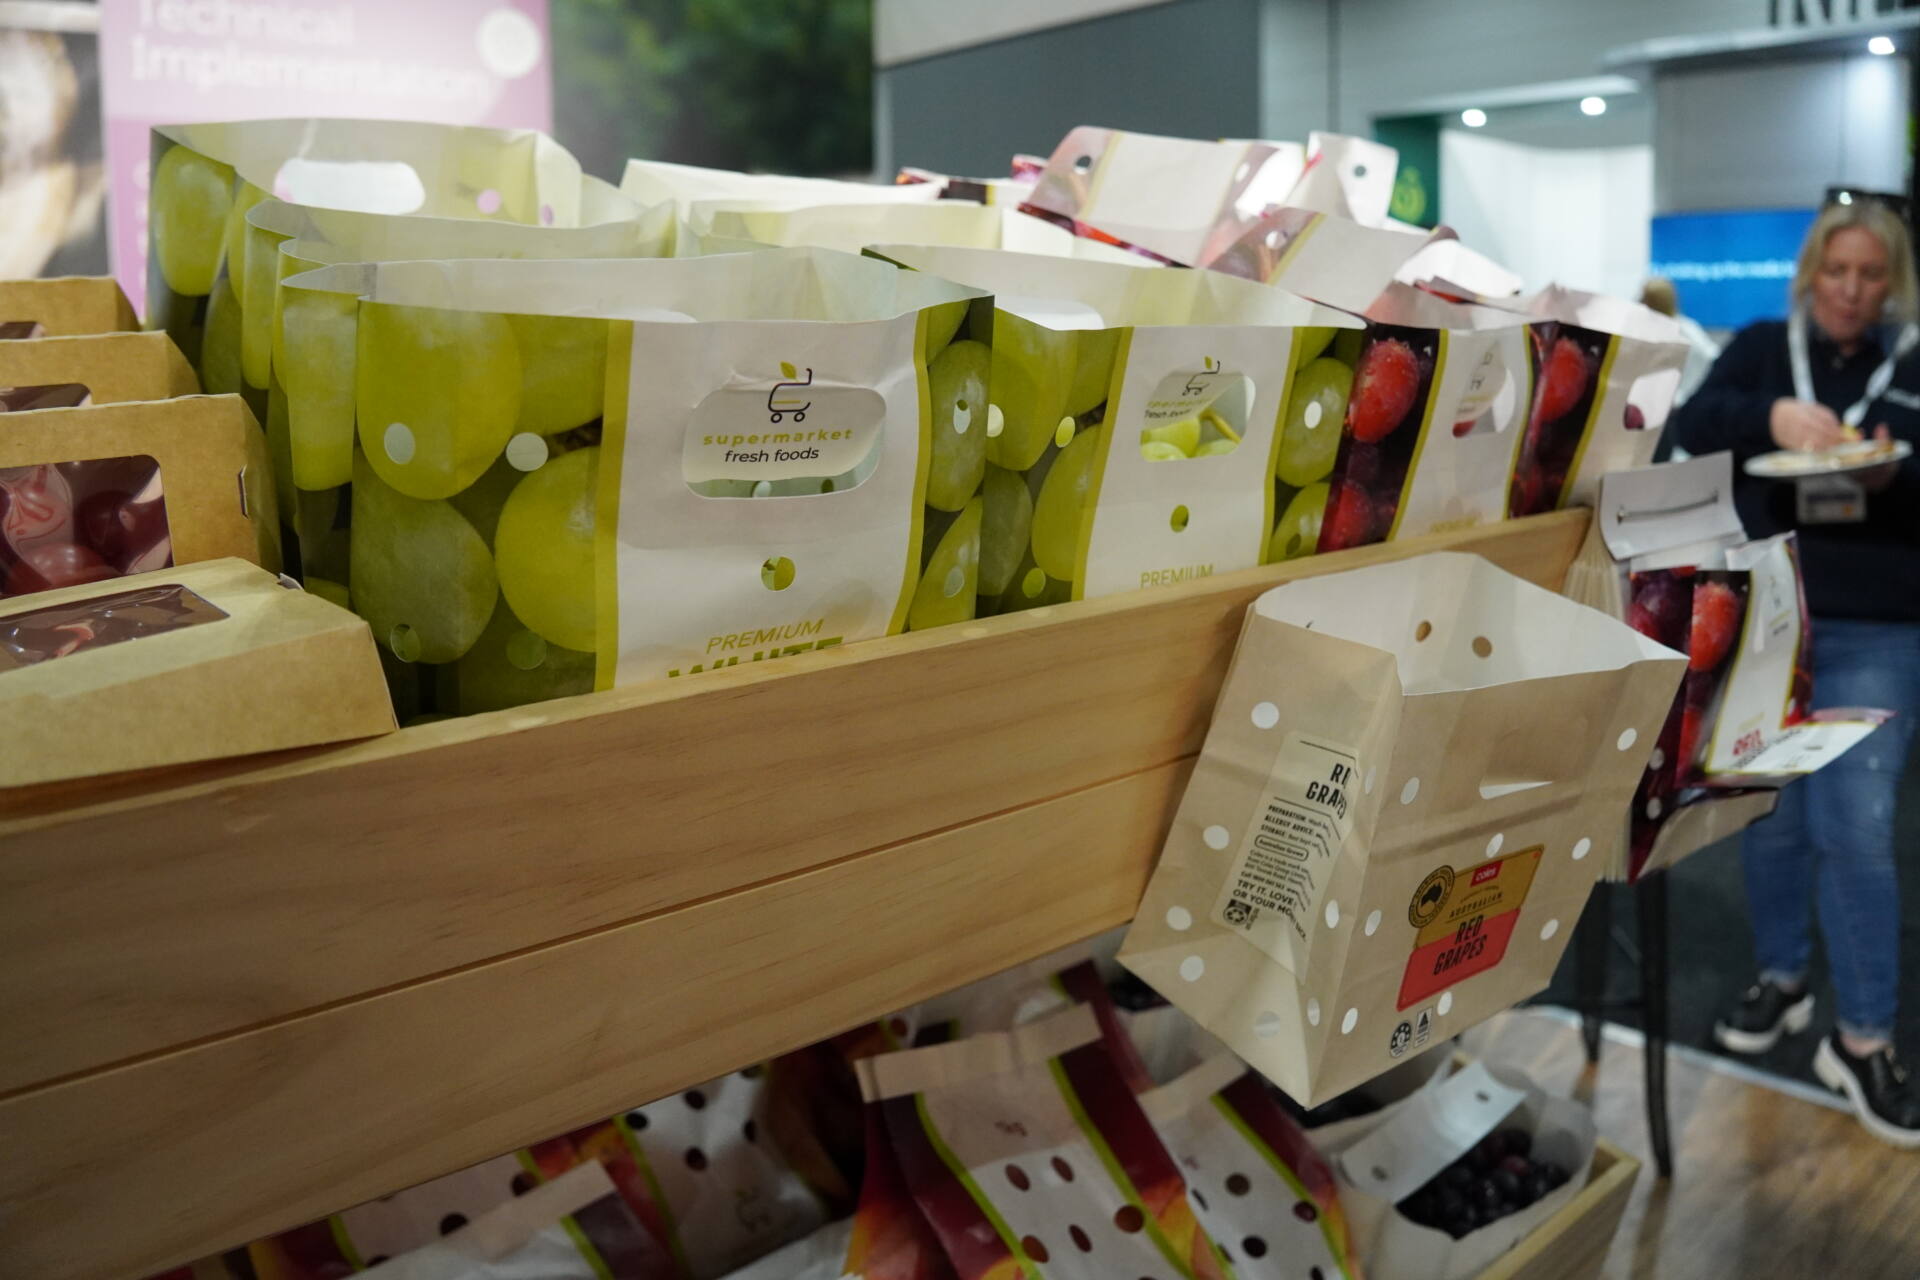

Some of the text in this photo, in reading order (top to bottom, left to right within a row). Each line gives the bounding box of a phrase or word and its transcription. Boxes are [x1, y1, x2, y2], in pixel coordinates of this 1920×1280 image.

[130, 33, 492, 101] Implementation
[703, 428, 854, 447] supermarket
[724, 446, 820, 463] fresh foods
[1140, 563, 1214, 589] PREMIUM
[706, 618, 825, 655] PREMIUM
[1233, 889, 1248, 899] OR
[1250, 894, 1276, 909] YOUR
[1238, 879, 1255, 891] TRY
[1269, 890, 1295, 906] LOVE
[1454, 914, 1485, 945] RED
[1433, 934, 1488, 976] GRAPES
